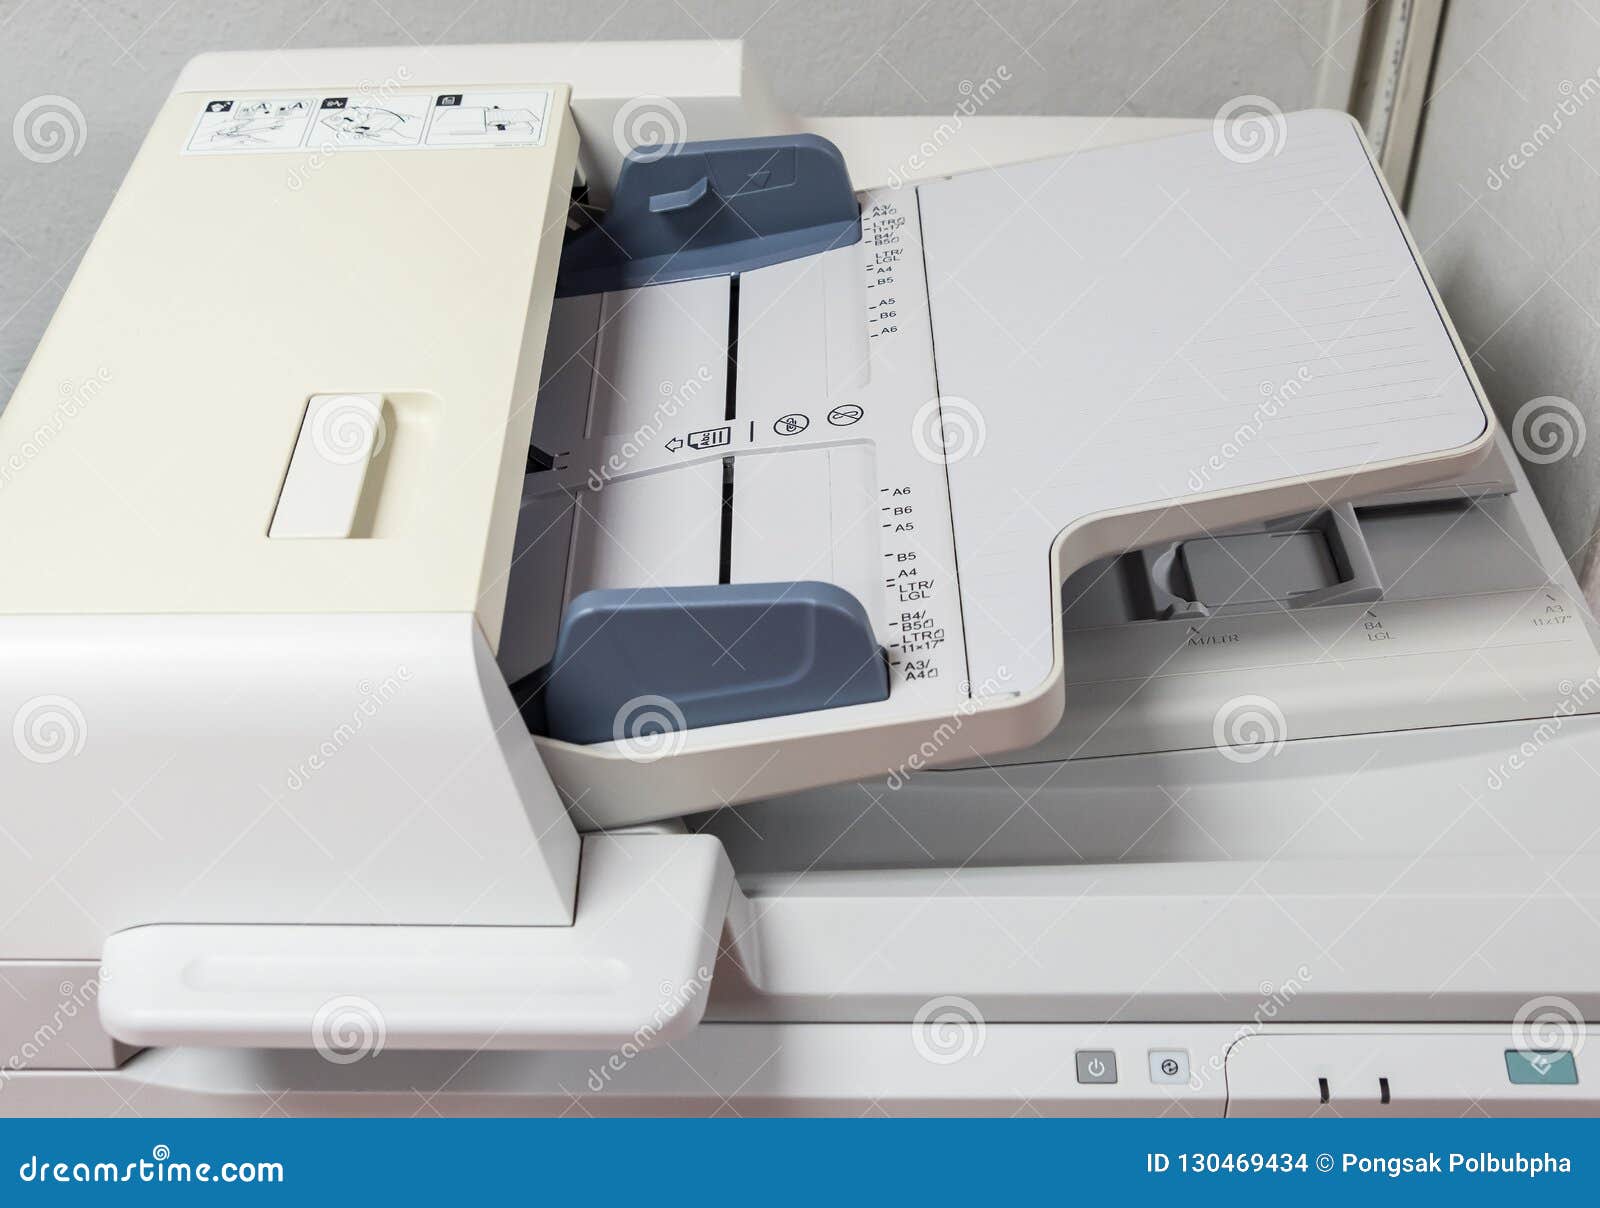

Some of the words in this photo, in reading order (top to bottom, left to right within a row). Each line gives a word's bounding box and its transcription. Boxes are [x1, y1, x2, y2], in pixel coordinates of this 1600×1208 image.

[875, 248, 904, 259] LTR/
[876, 255, 900, 265] LGL
[880, 311, 897, 320] B6
[892, 487, 912, 497] A6
[894, 506, 913, 516] B6
[895, 522, 914, 533] A5
[897, 551, 917, 563] B5
[898, 568, 917, 578] A4
[899, 579, 935, 593] LTR/
[900, 590, 931, 602] LGL
[901, 610, 926, 622] B4/
[903, 630, 932, 643] LTR
[905, 659, 930, 671] A3/
